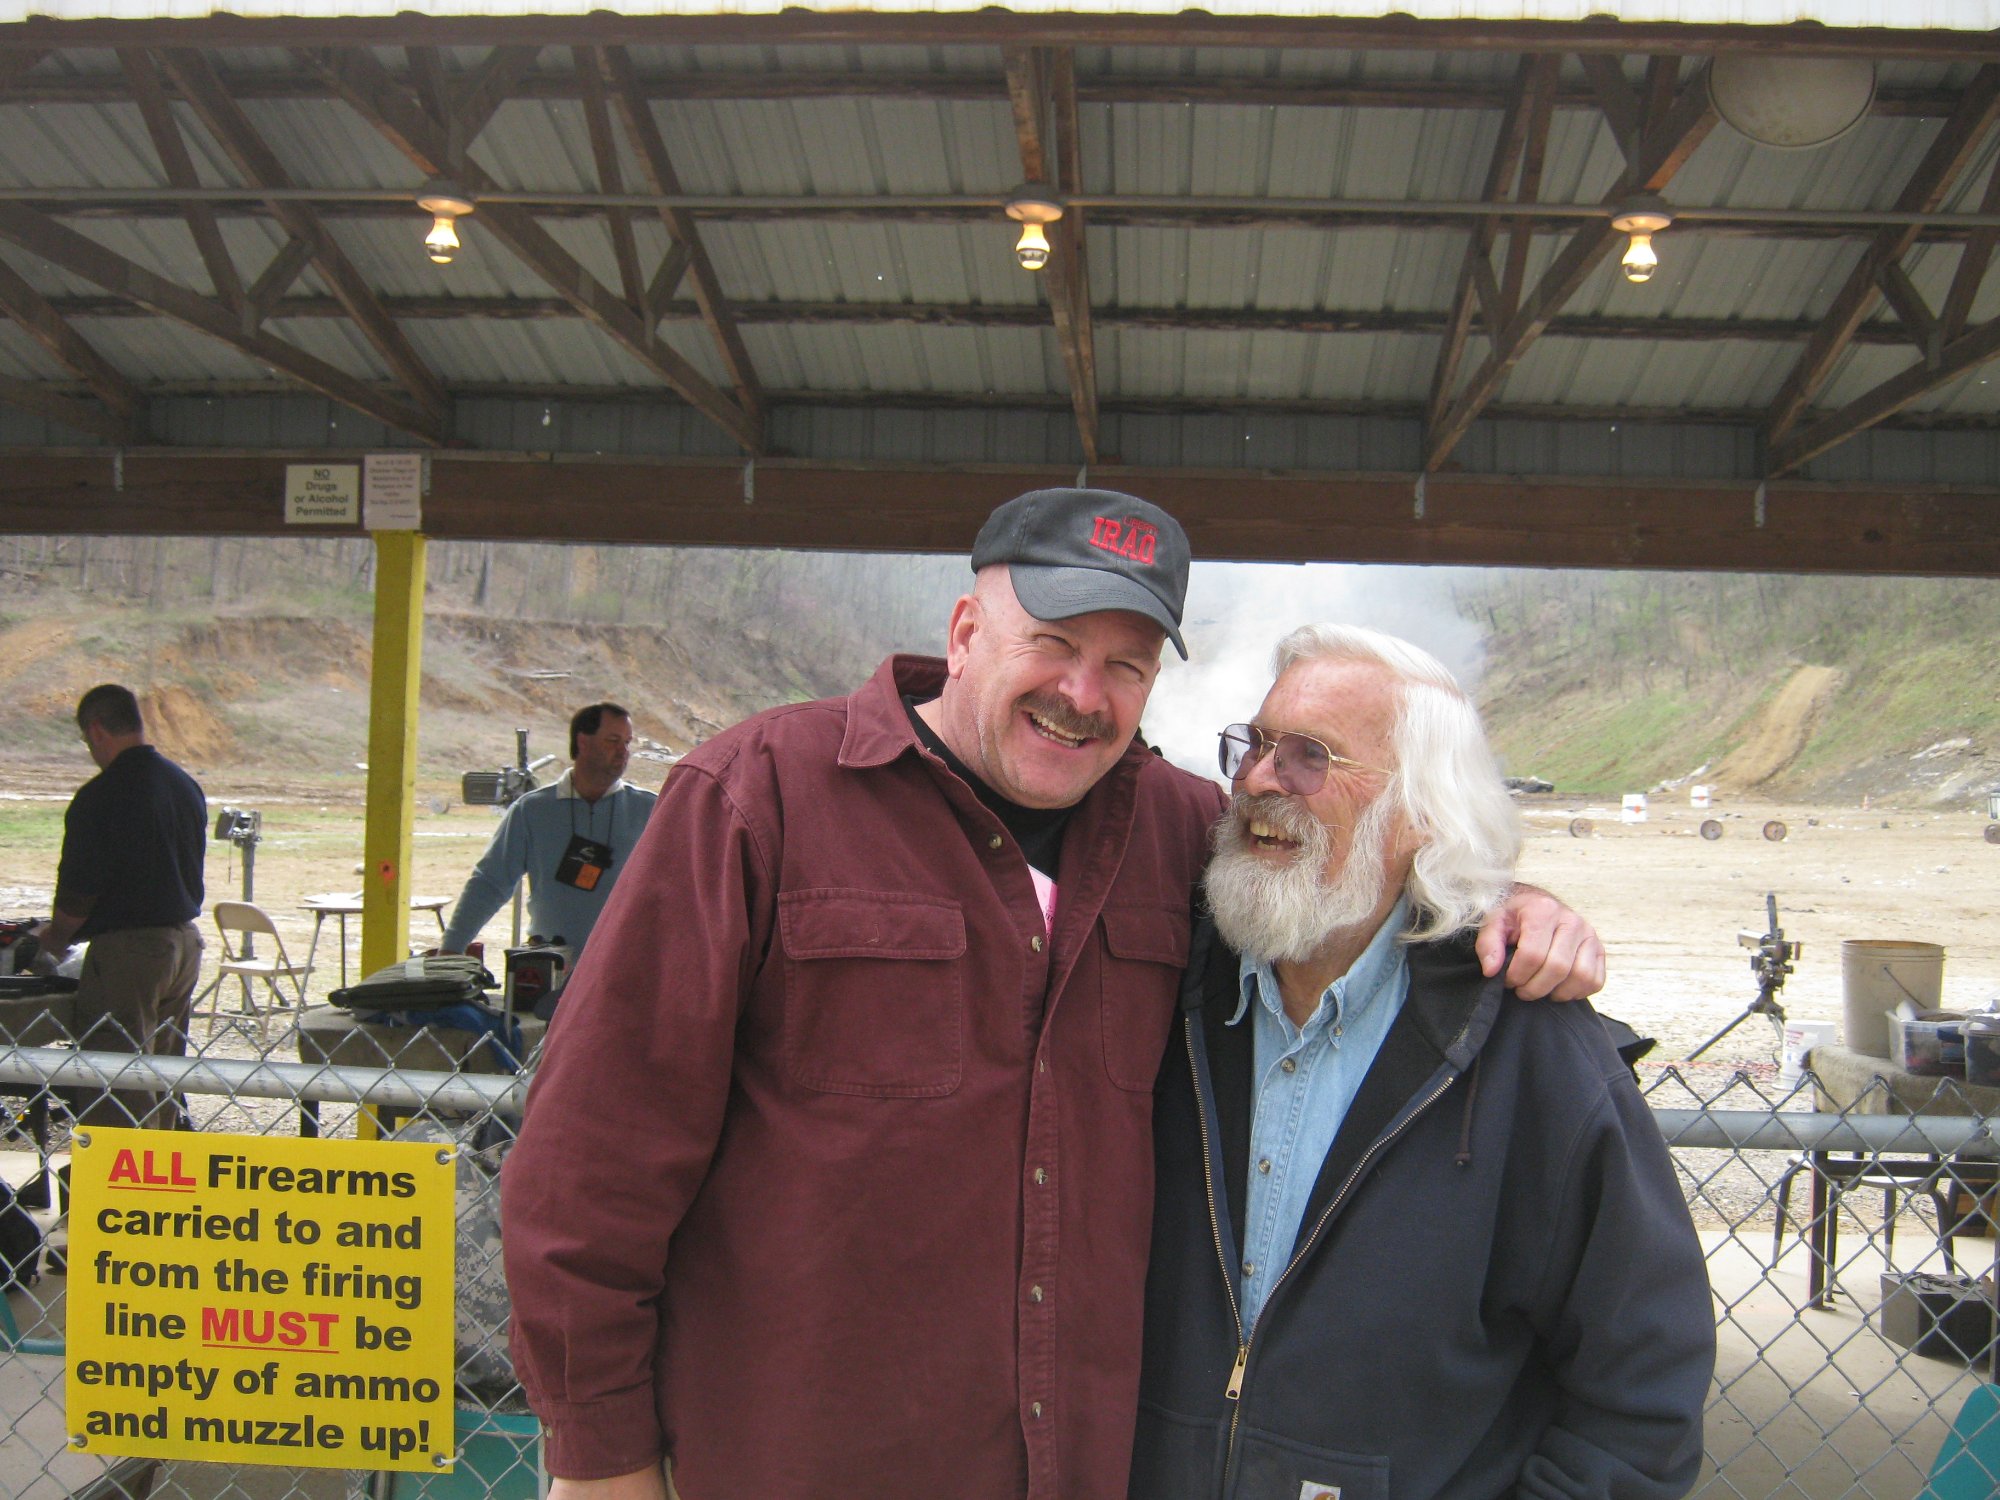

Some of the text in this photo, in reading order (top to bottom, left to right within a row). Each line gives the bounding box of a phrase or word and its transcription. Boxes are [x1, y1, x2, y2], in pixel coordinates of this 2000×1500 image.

[305, 482, 337, 492] Drugs
[313, 468, 330, 479] NO
[294, 494, 350, 504] or Alcohol
[295, 506, 347, 516] Permitted
[1089, 516, 1156, 565] IRAQ
[108, 1149, 417, 1198] ALL Firearms
[96, 1204, 422, 1250] carried to and
[93, 1250, 422, 1310] from the firing
[105, 1302, 412, 1352] line MUST be
[76, 1359, 440, 1404] empty of ammo
[85, 1406, 430, 1460] and muzzle up!
